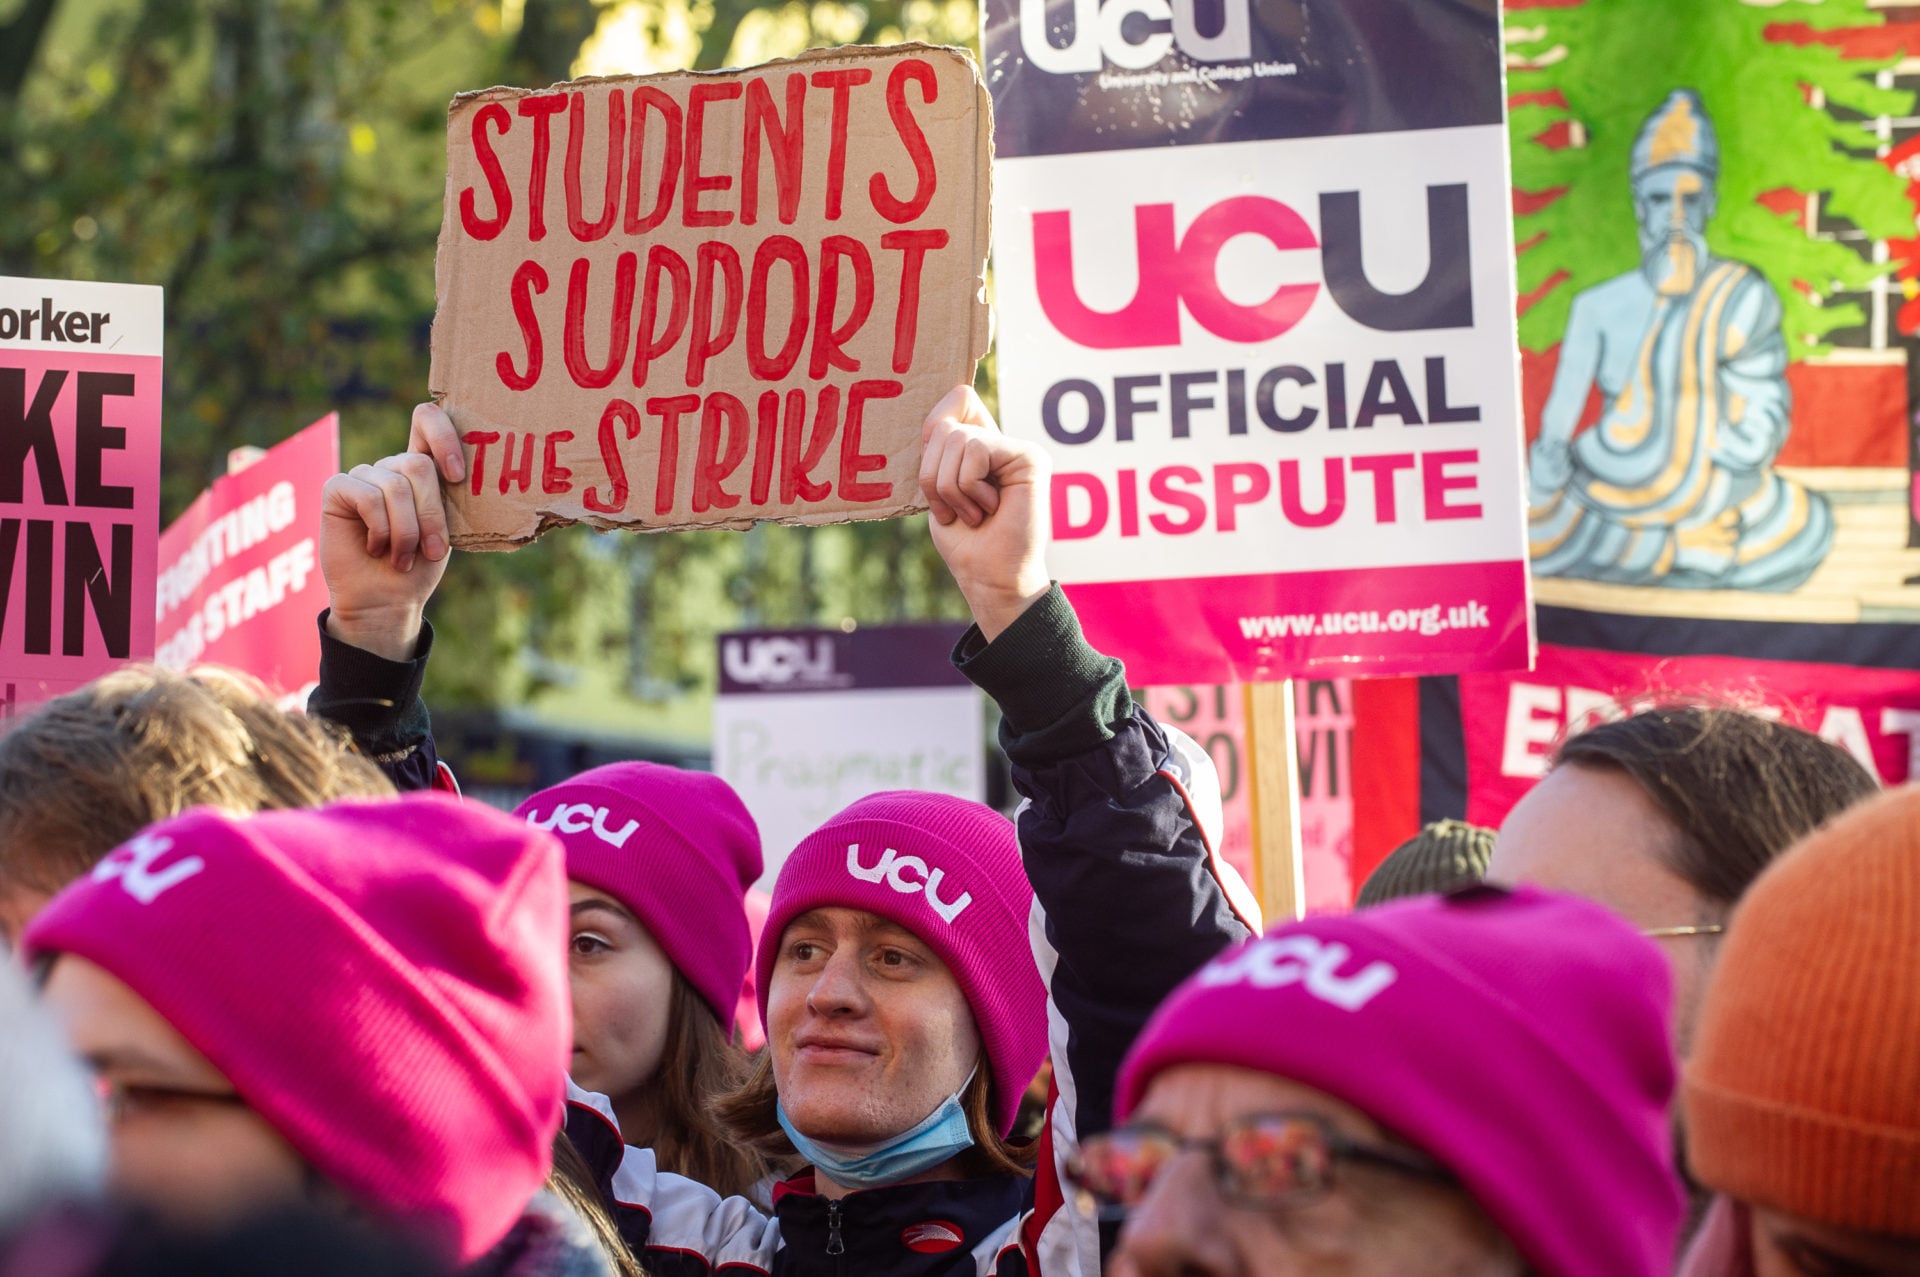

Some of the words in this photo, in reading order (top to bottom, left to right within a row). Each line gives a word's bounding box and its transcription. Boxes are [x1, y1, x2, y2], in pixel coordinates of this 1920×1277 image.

[1253, 61, 1297, 77] Union
[459, 59, 939, 242] STUDENTS
[496, 229, 949, 391] SUPPORT
[0, 367, 135, 509] KE
[461, 430, 574, 496] THE
[583, 379, 904, 516] STRIKE
[1041, 356, 1481, 446] OFFICIAL
[1050, 449, 1483, 541] DISPUTE
[203, 537, 315, 642] STAFF
[1239, 600, 1490, 639] www.ucu.org.uk
